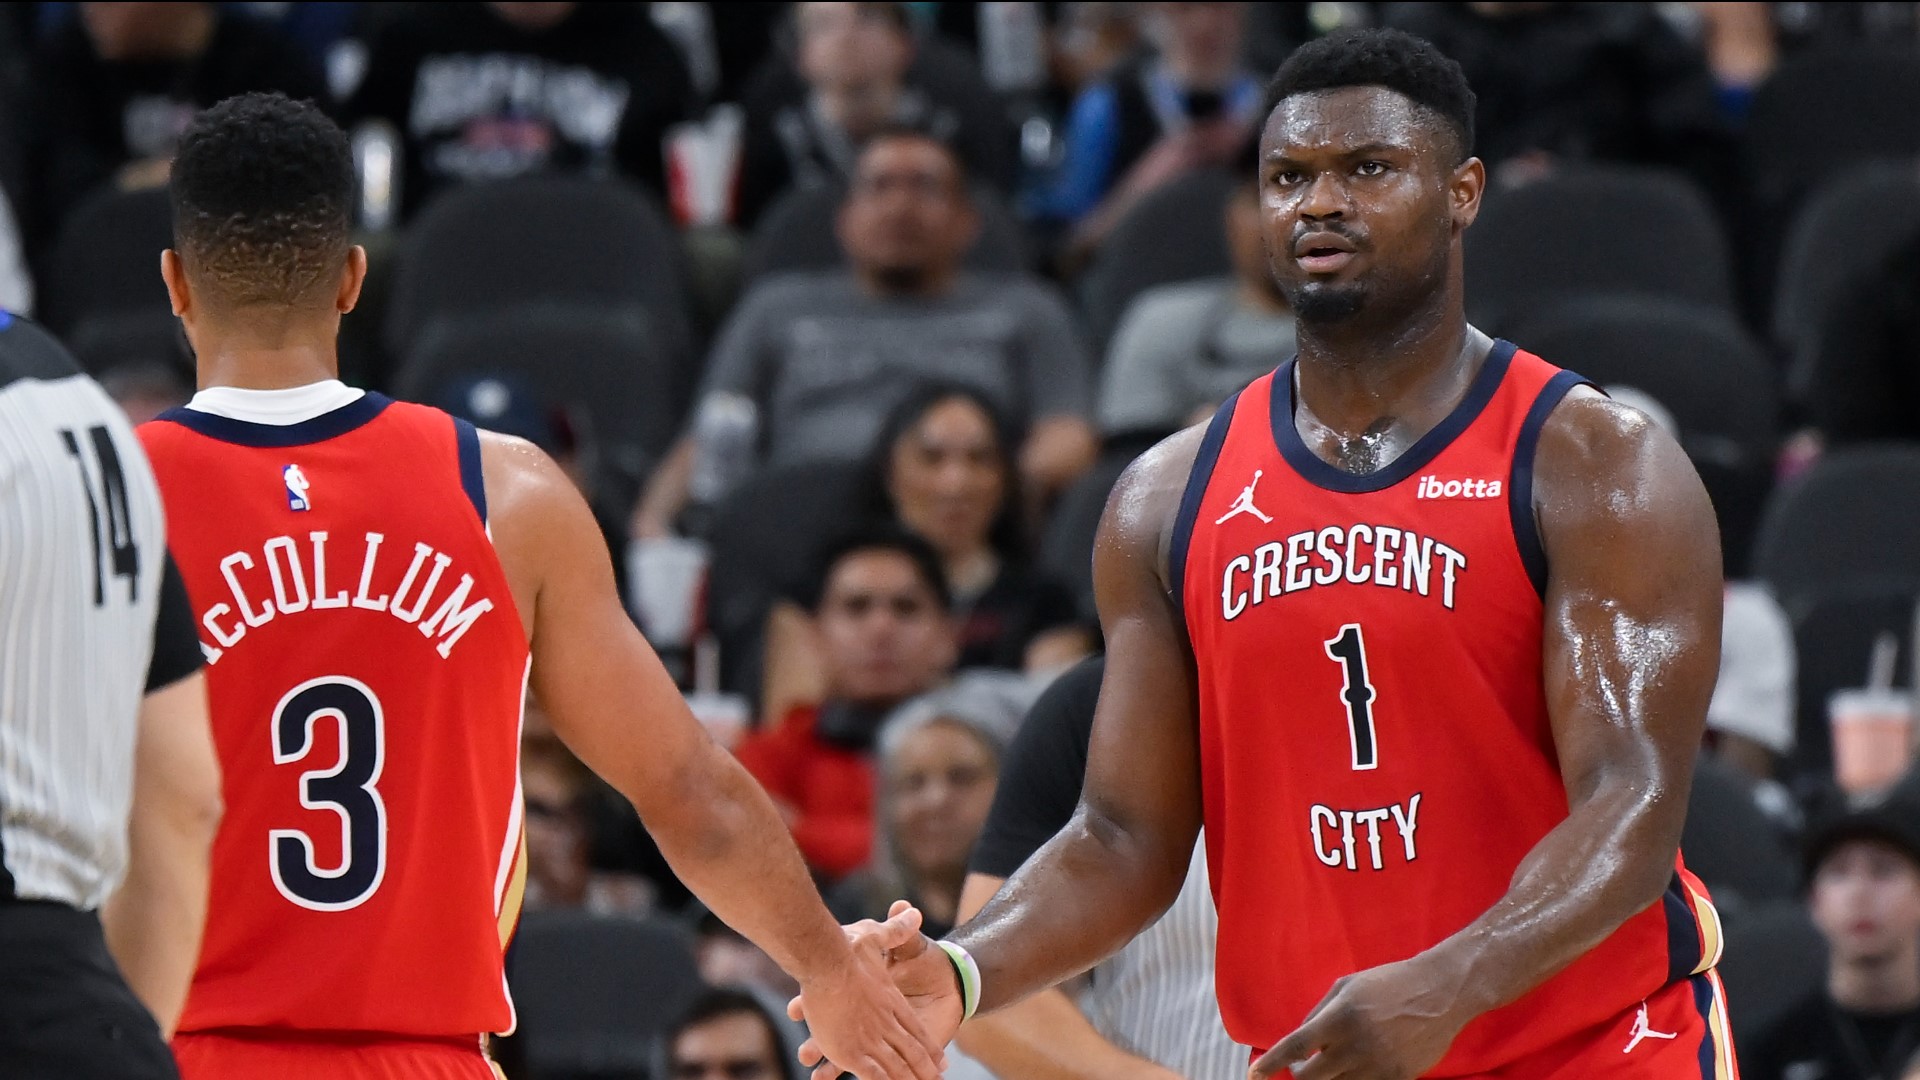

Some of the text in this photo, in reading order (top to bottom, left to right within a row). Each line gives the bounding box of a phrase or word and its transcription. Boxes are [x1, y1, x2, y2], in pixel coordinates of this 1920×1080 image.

[58, 424, 141, 608] 14
[1417, 475, 1502, 500] ibotta
[1221, 524, 1467, 621] CRESCENT
[1324, 623, 1377, 770] 1
[269, 675, 387, 912] 3
[1310, 792, 1421, 871] CITY
